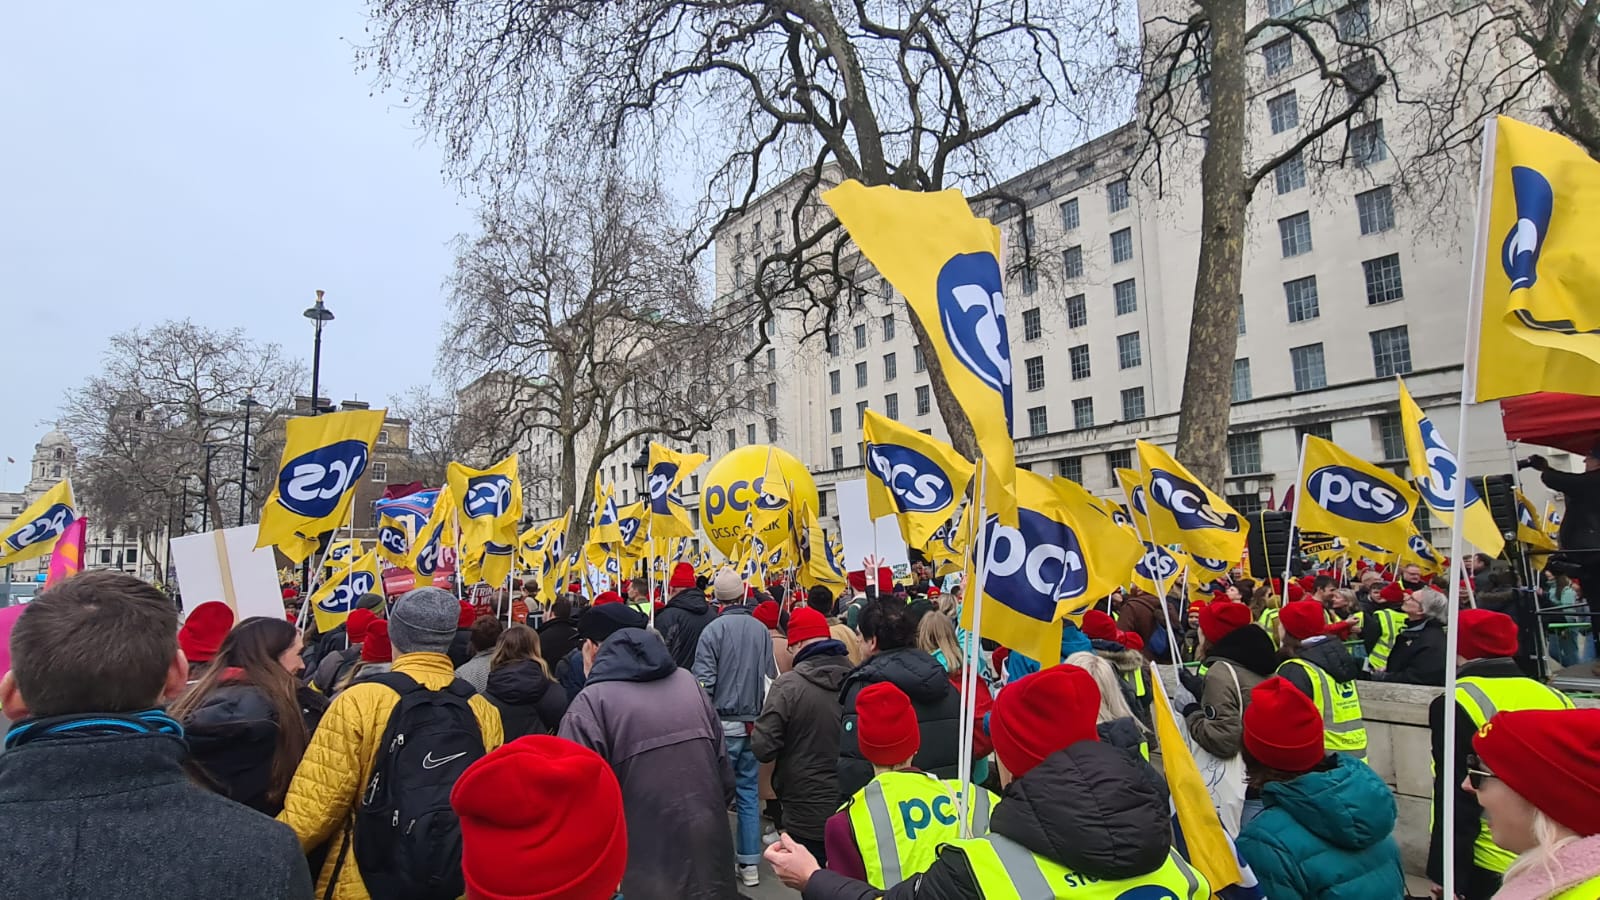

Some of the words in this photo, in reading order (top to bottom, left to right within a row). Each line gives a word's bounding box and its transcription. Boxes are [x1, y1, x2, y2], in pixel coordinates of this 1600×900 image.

[872, 448, 945, 506] pcs
[1318, 471, 1398, 515] pcs
[381, 528, 408, 552] pcs
[1138, 551, 1174, 575] cs
[898, 791, 962, 840] pc
